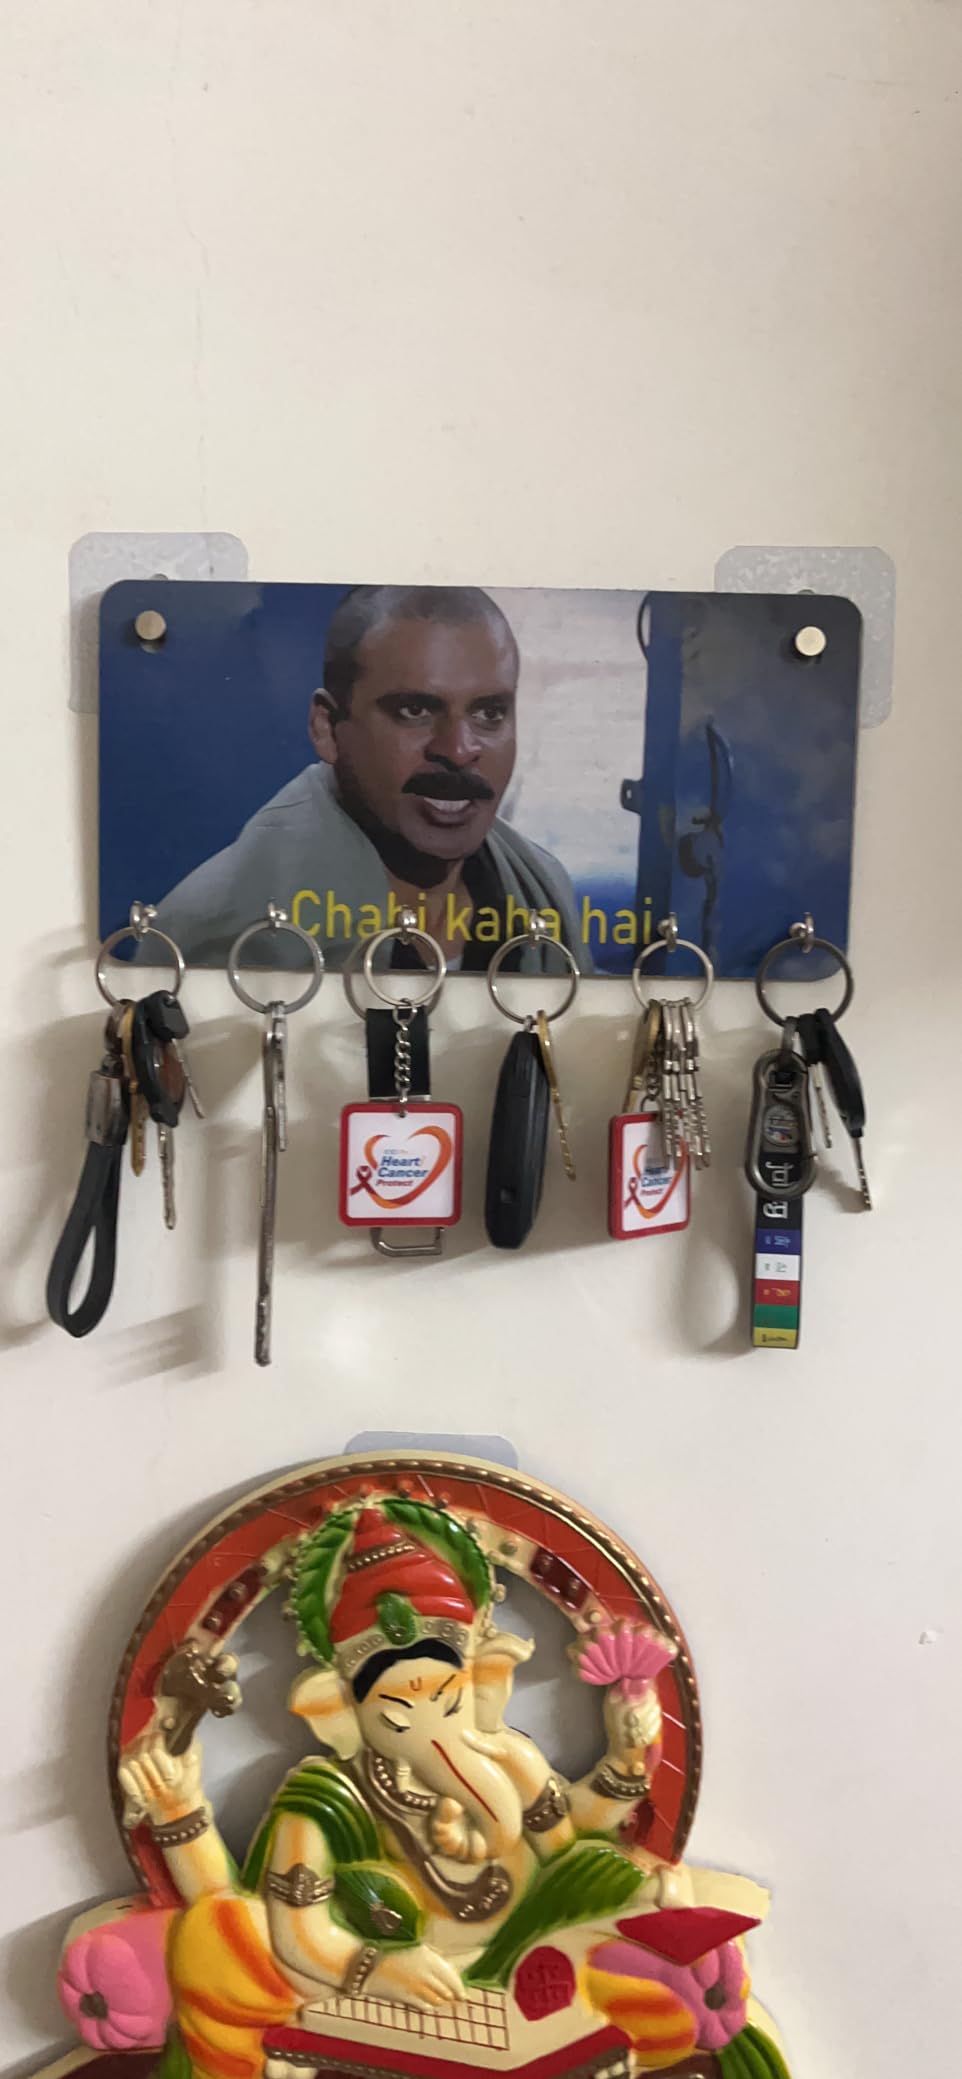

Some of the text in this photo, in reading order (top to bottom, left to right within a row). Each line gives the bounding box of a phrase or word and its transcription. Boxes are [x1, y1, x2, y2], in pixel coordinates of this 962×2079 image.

[447, 894, 561, 942] kaha
[582, 896, 652, 945] hai
[381, 1156, 420, 1166] Heart
[378, 1167, 428, 1177] Cancer
